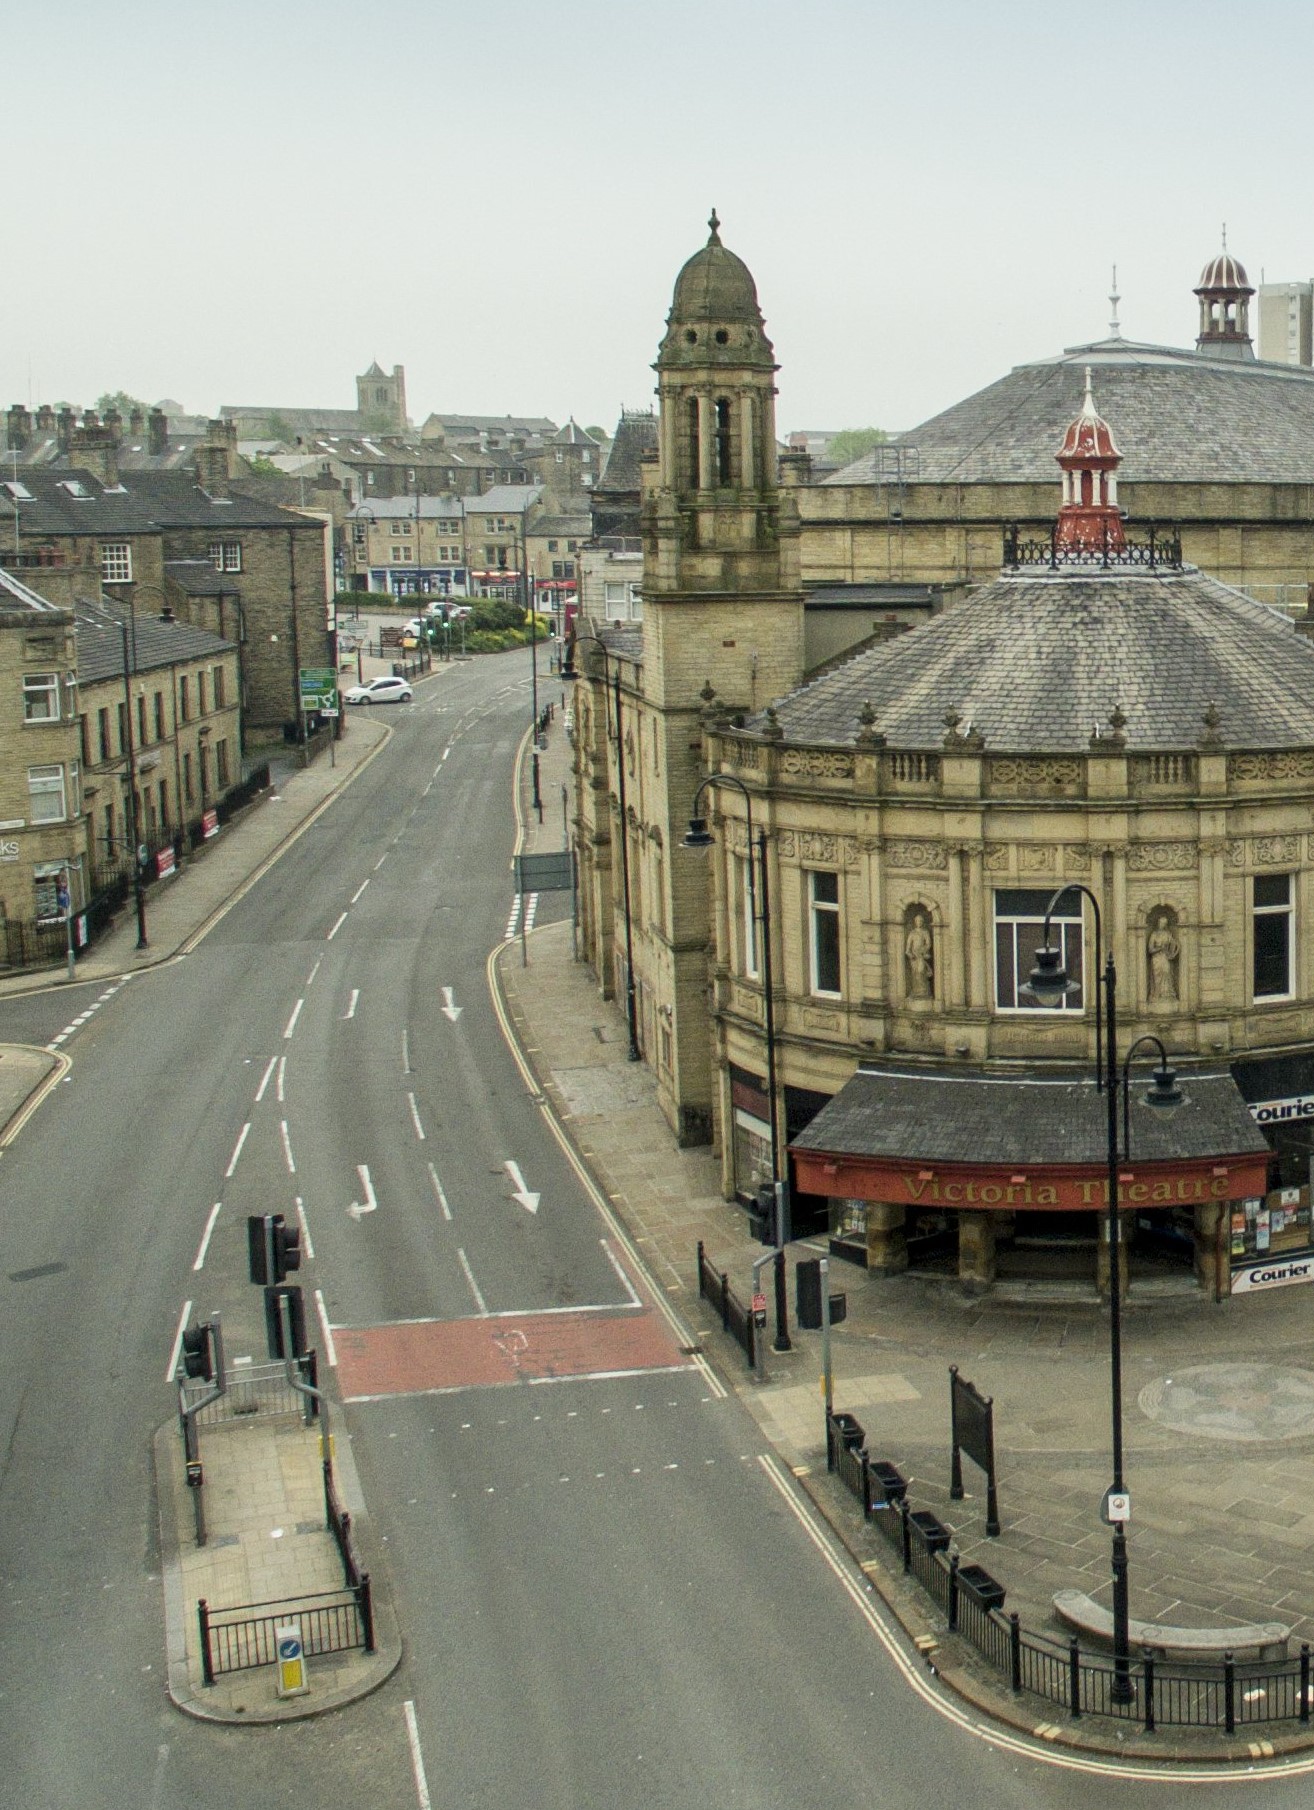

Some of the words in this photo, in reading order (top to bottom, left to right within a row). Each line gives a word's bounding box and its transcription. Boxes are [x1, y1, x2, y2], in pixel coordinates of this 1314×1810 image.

[903, 1176, 1060, 1204] Victoria
[1074, 1175, 1229, 1204] Theatre
[1249, 1263, 1311, 1284] Courier
